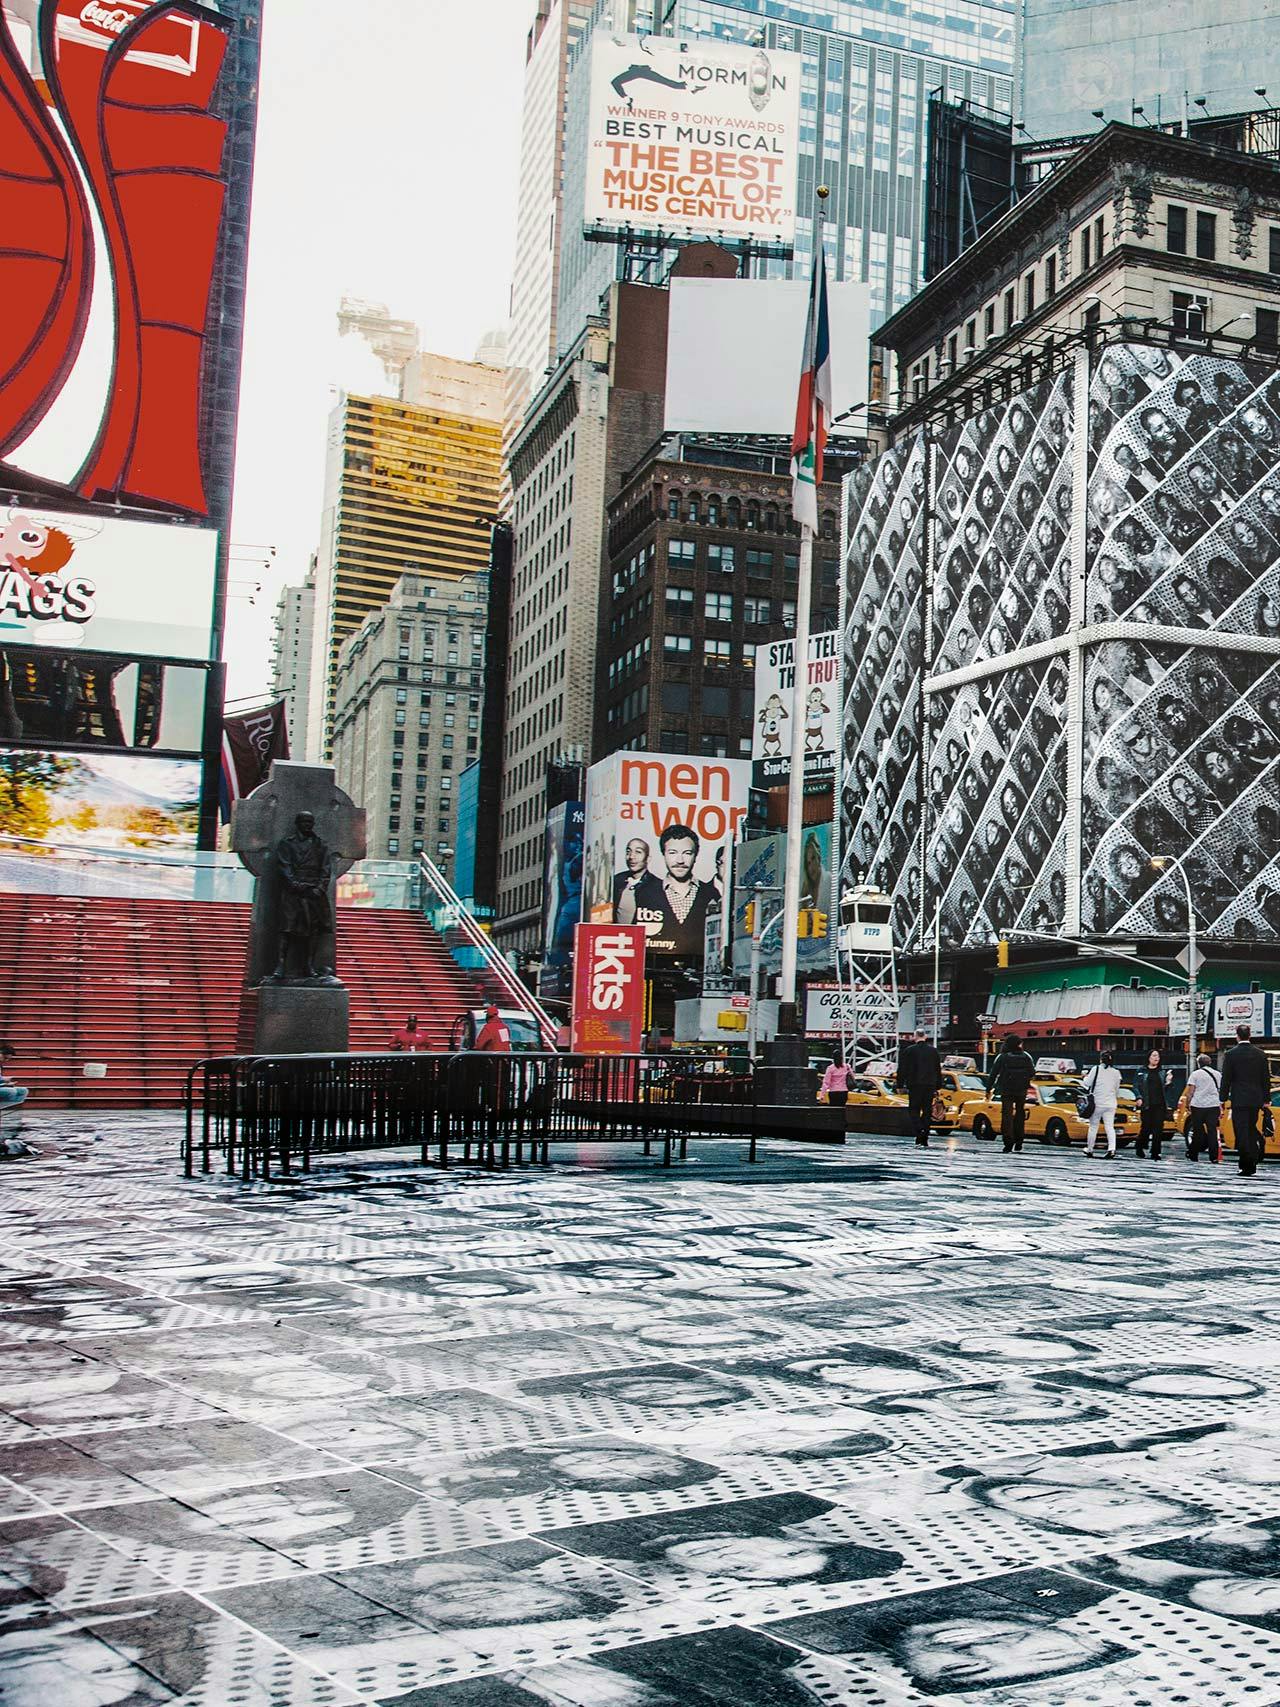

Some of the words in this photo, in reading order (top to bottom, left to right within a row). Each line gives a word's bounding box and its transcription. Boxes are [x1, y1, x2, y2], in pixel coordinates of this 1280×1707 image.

[606, 119, 667, 140] BEST
[676, 127, 784, 154] MUSICAL
[608, 105, 673, 121] WINNER
[671, 110, 680, 122] 9
[683, 112, 723, 126] TONY
[725, 117, 785, 134] AWARDS
[689, 148, 784, 183] BEST
[603, 168, 735, 200] MUSICAL
[742, 182, 783, 205] OF
[603, 190, 660, 212] THIS
[0, 567, 96, 624] AGS
[778, 665, 796, 690] TH
[620, 759, 730, 802] men
[620, 800, 645, 821] at
[636, 907, 664, 921] tbs
[592, 932, 635, 1011] tkts
